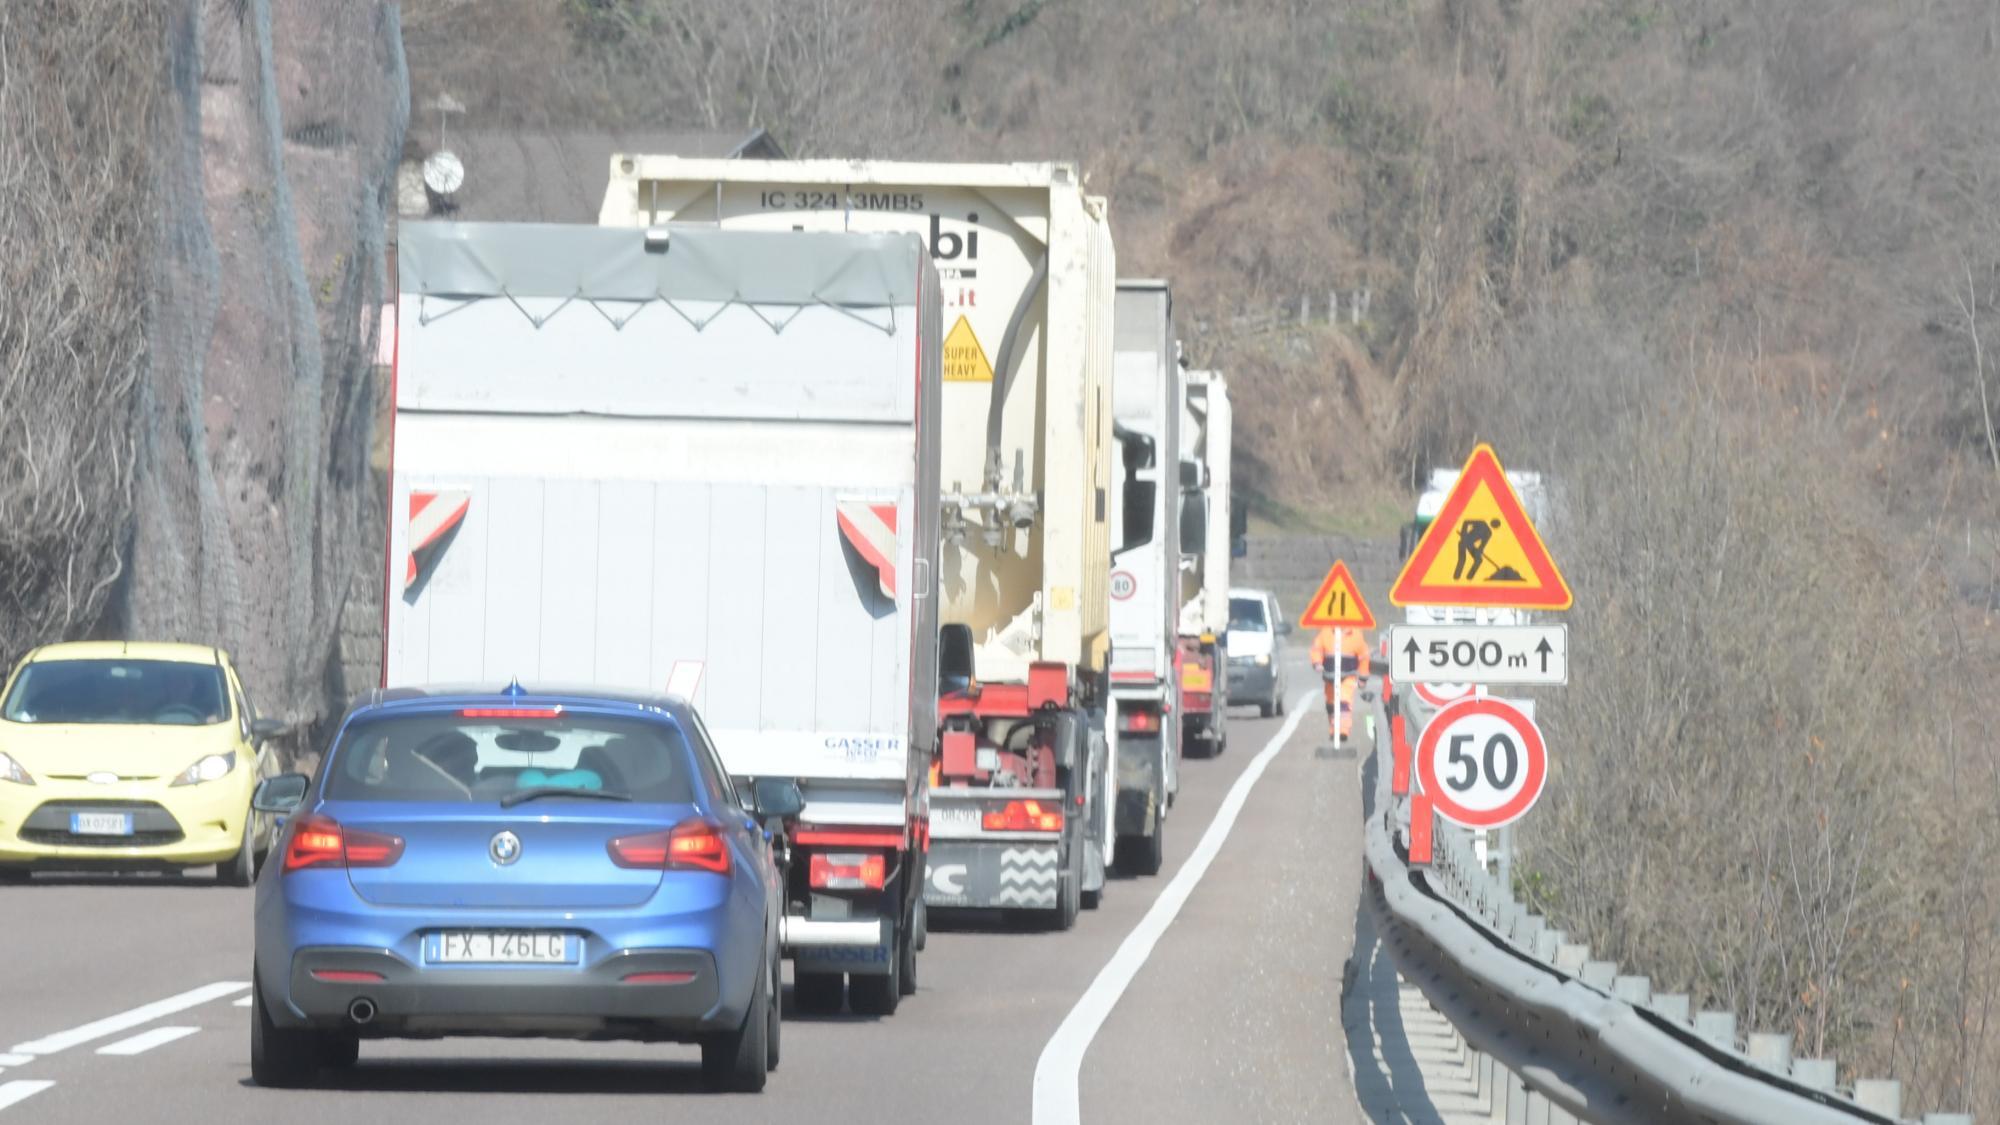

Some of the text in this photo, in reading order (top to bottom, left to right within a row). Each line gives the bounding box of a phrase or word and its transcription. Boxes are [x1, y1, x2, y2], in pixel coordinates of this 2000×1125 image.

[761, 191, 924, 210] IC 324 3MB5
[944, 346, 978, 360] SUPER
[944, 364, 976, 376] HEAVY
[1114, 579, 1129, 593] 80
[1428, 640, 1528, 668] 500 m
[824, 737, 899, 750] GASSER
[1445, 732, 1518, 792] 50
[445, 932, 562, 957] FX 146LG
